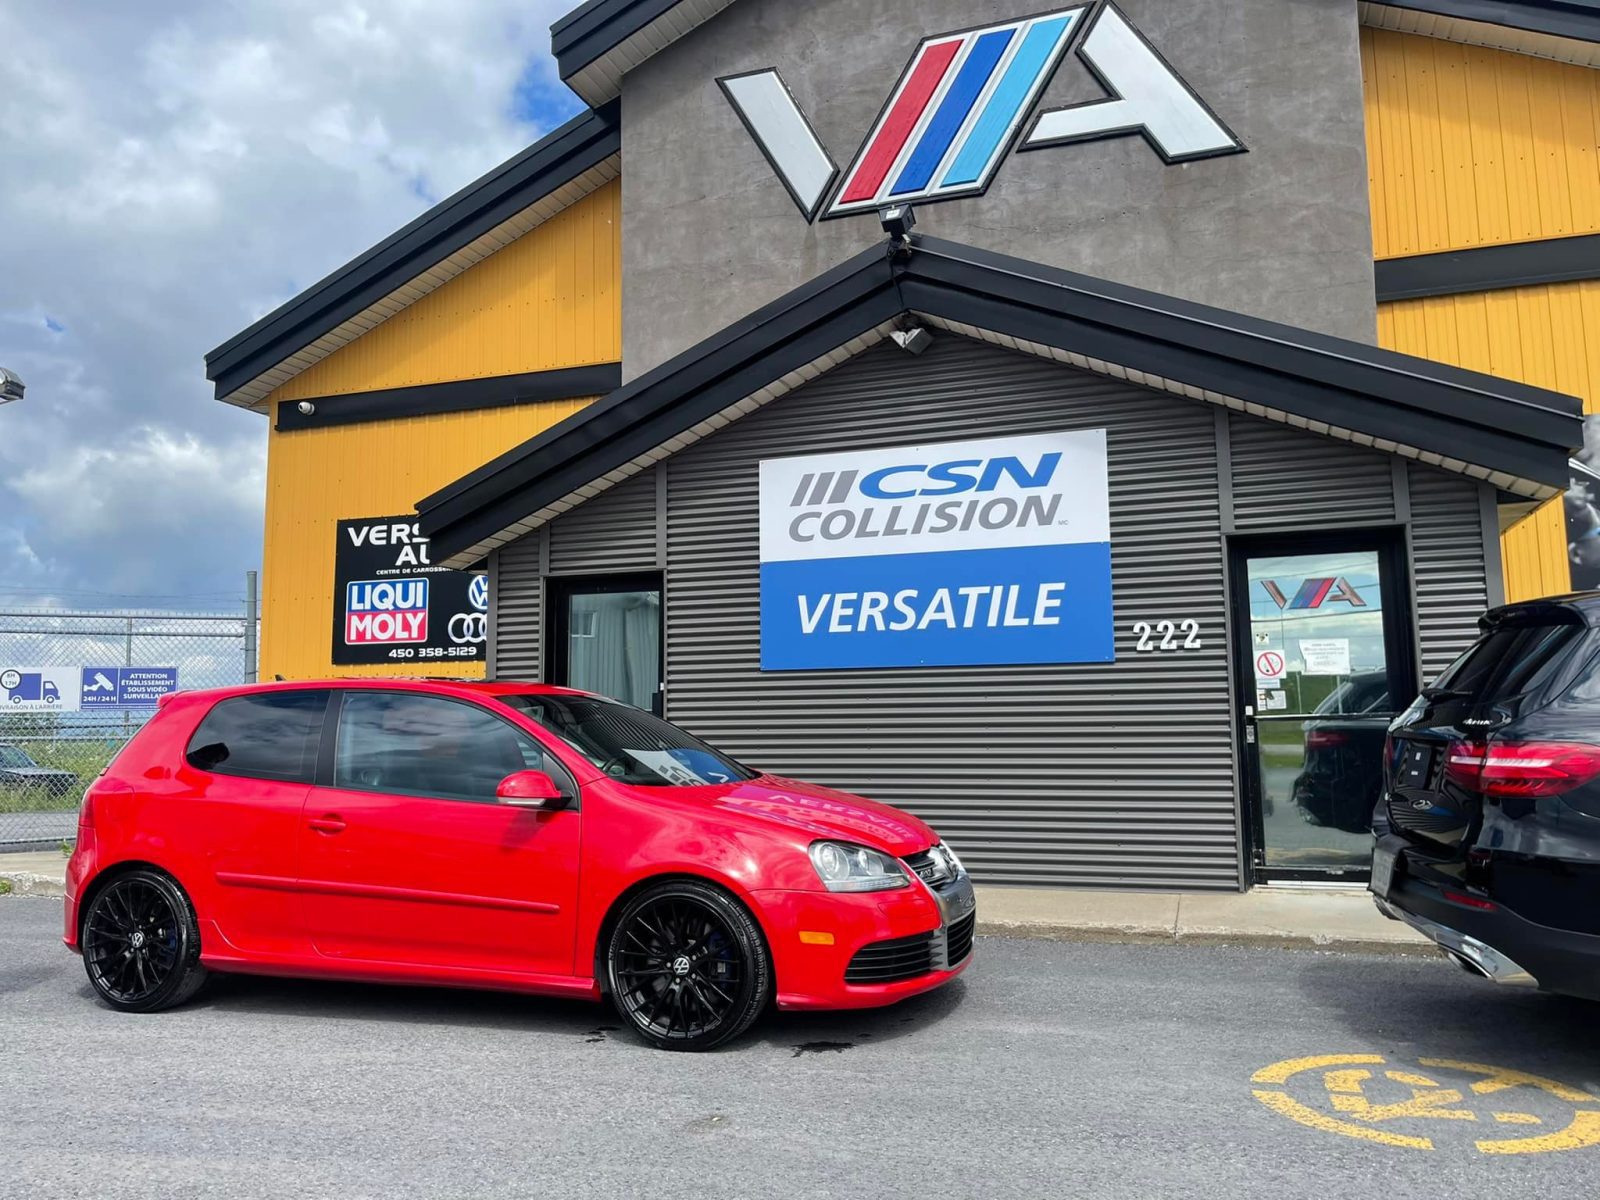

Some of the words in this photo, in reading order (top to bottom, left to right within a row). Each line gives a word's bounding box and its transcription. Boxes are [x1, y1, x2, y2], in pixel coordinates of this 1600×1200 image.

[859, 452, 1063, 500] CSN
[788, 493, 1063, 543] COLLISION
[376, 568, 400, 576] CENTRE
[402, 567, 411, 575] DE
[350, 581, 424, 611] LIQUI
[797, 581, 1066, 634] VERSATILE
[350, 612, 425, 641] MOLY
[1132, 619, 1201, 652] 222
[388, 648, 414, 658] 450
[418, 646, 477, 658] 358-5129
